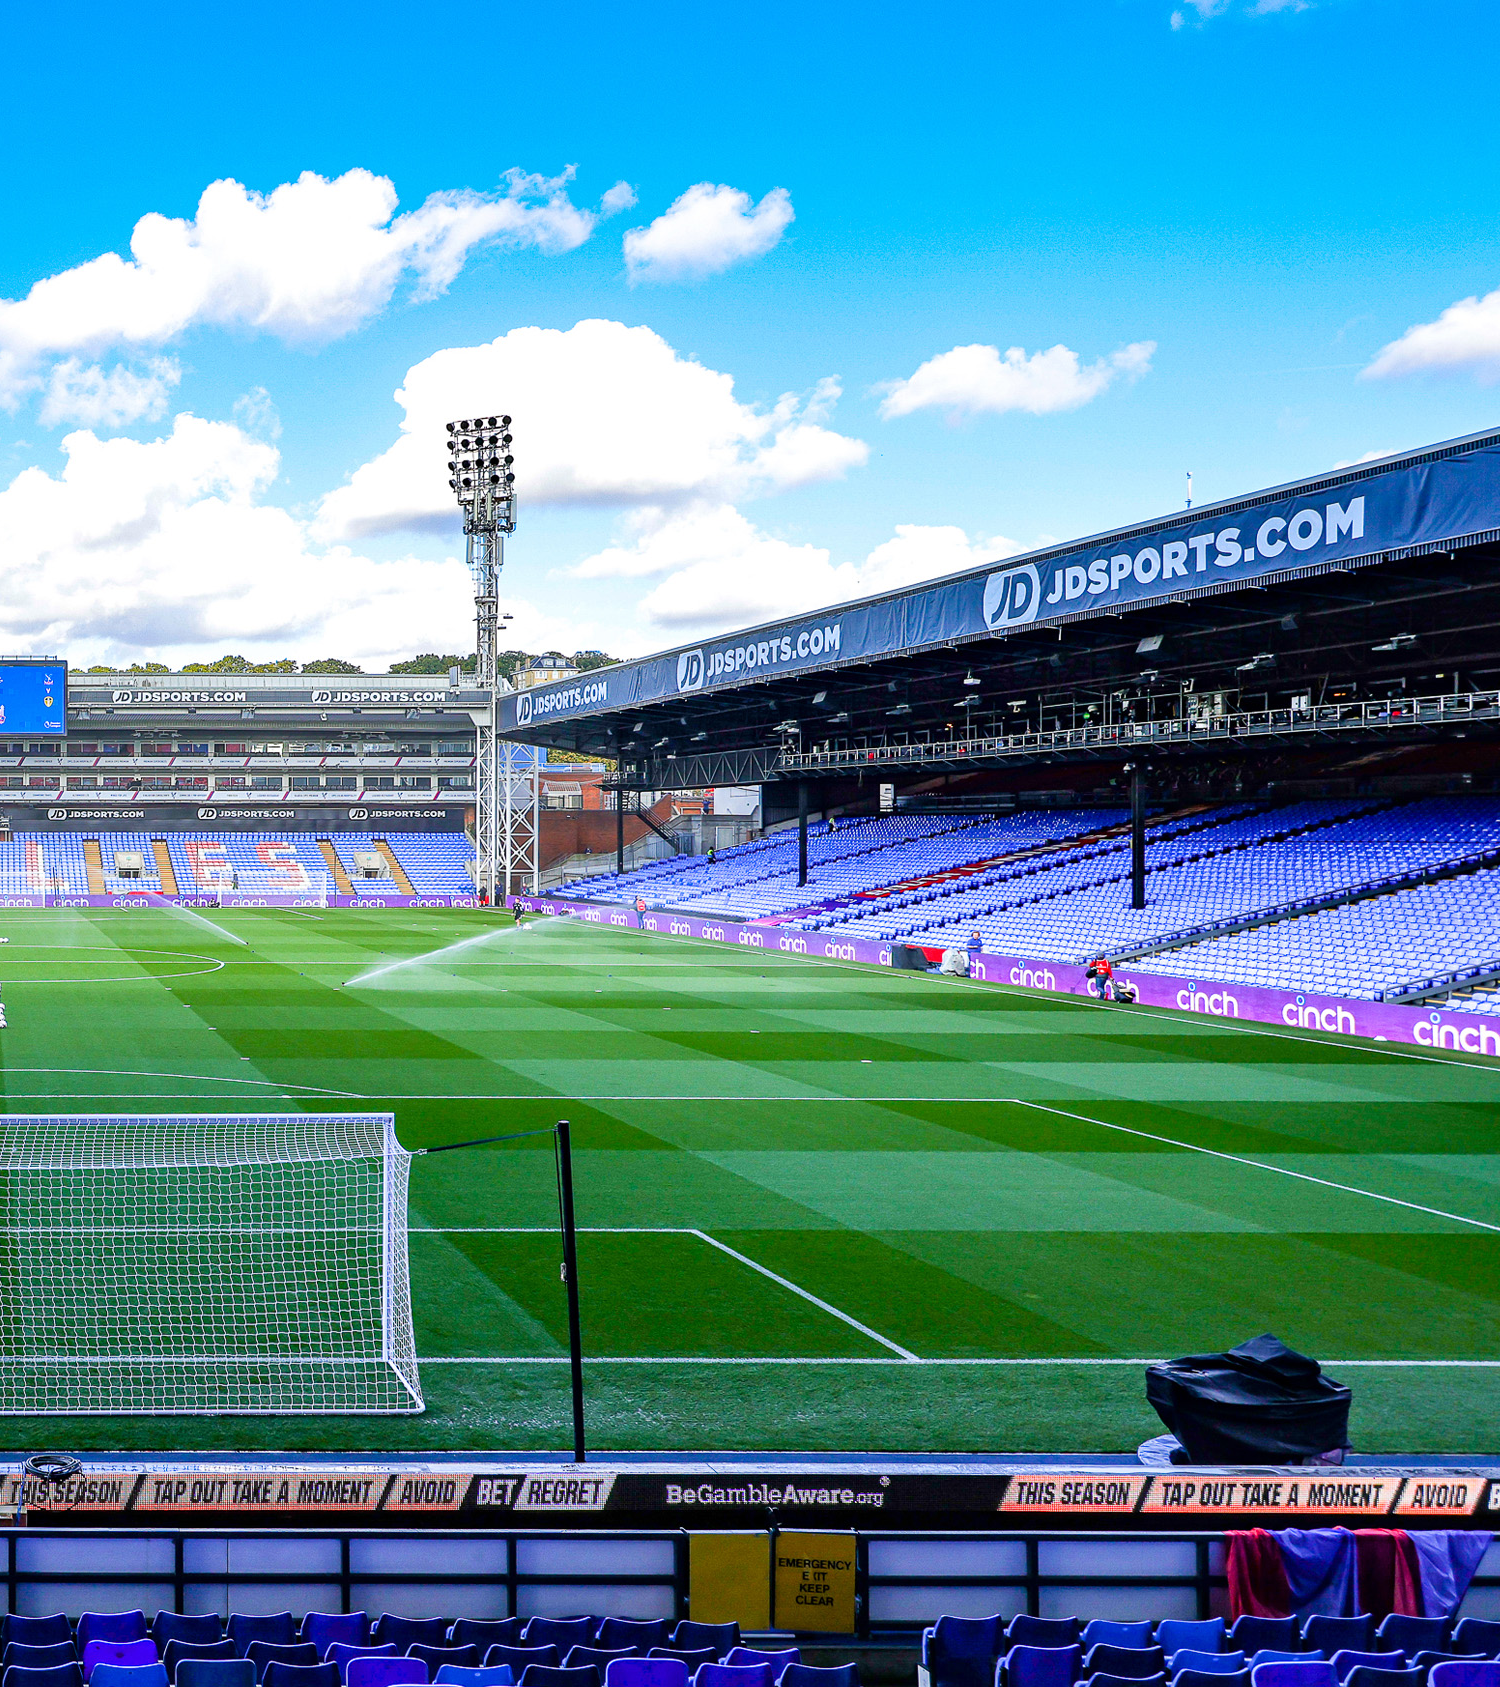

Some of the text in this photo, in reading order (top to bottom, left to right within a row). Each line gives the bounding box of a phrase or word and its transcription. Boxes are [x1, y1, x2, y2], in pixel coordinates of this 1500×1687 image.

[1046, 496, 1365, 604] JDSPORTS.COM
[707, 623, 841, 677] JDSPORTS.COM
[133, 691, 246, 702] JDSPORTS.COM
[332, 691, 446, 702] JDSPORTS.COM
[533, 682, 607, 715] JDSPORTS.COM
[68, 808, 144, 818] JDSPORTS.COM
[218, 808, 295, 818] JDSPORTS.COM
[370, 808, 446, 818] JDSPORTS.COM
[52, 894, 89, 908] cinch
[112, 894, 149, 908] cinch
[172, 894, 208, 908] cinch
[232, 894, 268, 908] cinch
[293, 894, 329, 908] cinch
[350, 894, 386, 908] cinch
[409, 894, 445, 908] cinch
[670, 917, 690, 936] cinch
[702, 921, 724, 942] cinch
[738, 926, 764, 948] cinch
[780, 931, 807, 954] cinch
[824, 937, 856, 960] cinch
[1010, 960, 1056, 991] cinch
[1176, 981, 1238, 1018] cinch
[1282, 995, 1356, 1034] cinch
[1413, 1012, 1500, 1056] cinch
[11, 1481, 124, 1504] THIS SEASON
[153, 1480, 374, 1503] TAP OUT TAKE A MOMENT
[401, 1480, 456, 1504] AVOID
[476, 1479, 605, 1506] BET REGRET
[1016, 1482, 1132, 1506] THIS SEASON
[1161, 1482, 1384, 1508] TAP OUT TAKE A MOMENT
[1411, 1484, 1468, 1508] AVOID
[778, 1558, 852, 1571] EMERGENCY
[800, 1584, 830, 1594] KEEP
[795, 1596, 834, 1607] CLEAR
